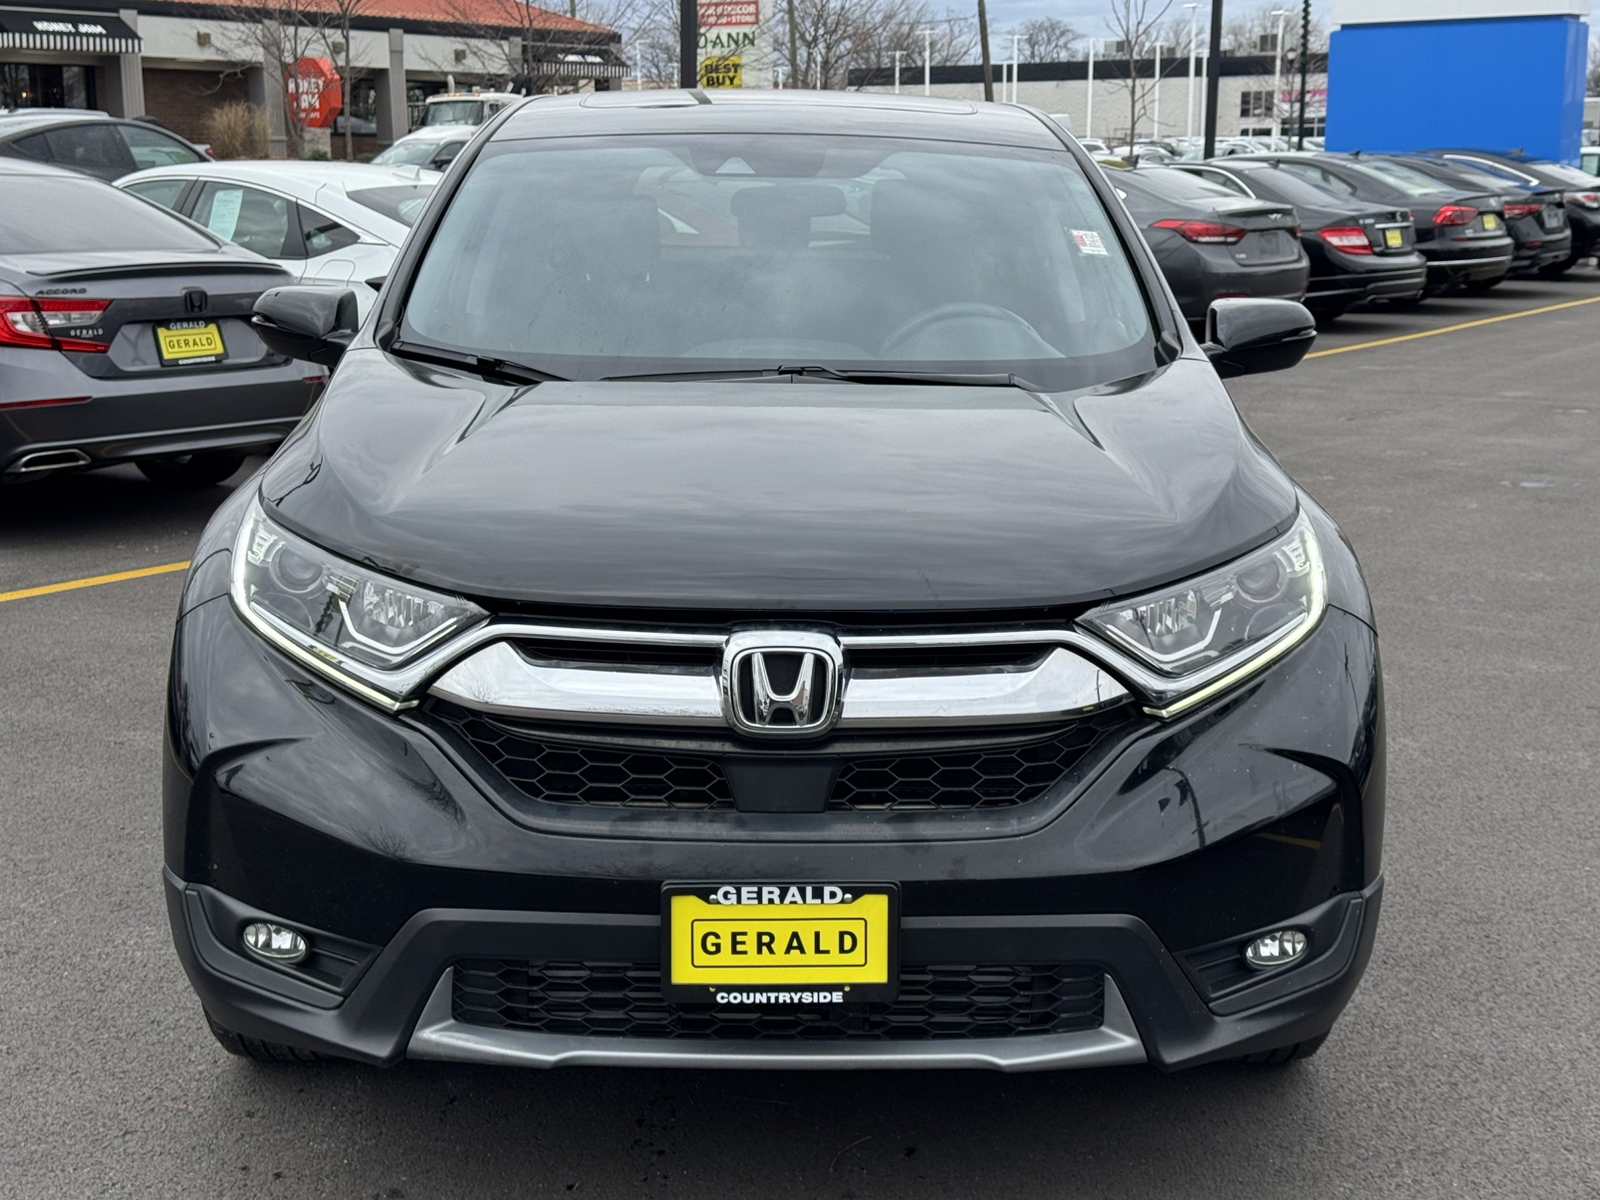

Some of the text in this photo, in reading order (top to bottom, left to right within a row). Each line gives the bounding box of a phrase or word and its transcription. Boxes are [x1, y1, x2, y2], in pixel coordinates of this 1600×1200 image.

[697, 31, 756, 49] O-ANN
[704, 64, 741, 74] BEST
[706, 75, 737, 86] BUY
[35, 287, 87, 296] ACCORD
[169, 320, 206, 331] GERALD
[70, 328, 104, 337] GERALD
[168, 336, 213, 350] GERALD
[716, 886, 843, 905] GERALD
[700, 930, 858, 956] GERALD
[716, 992, 843, 1004] COUNTRYSIDE
